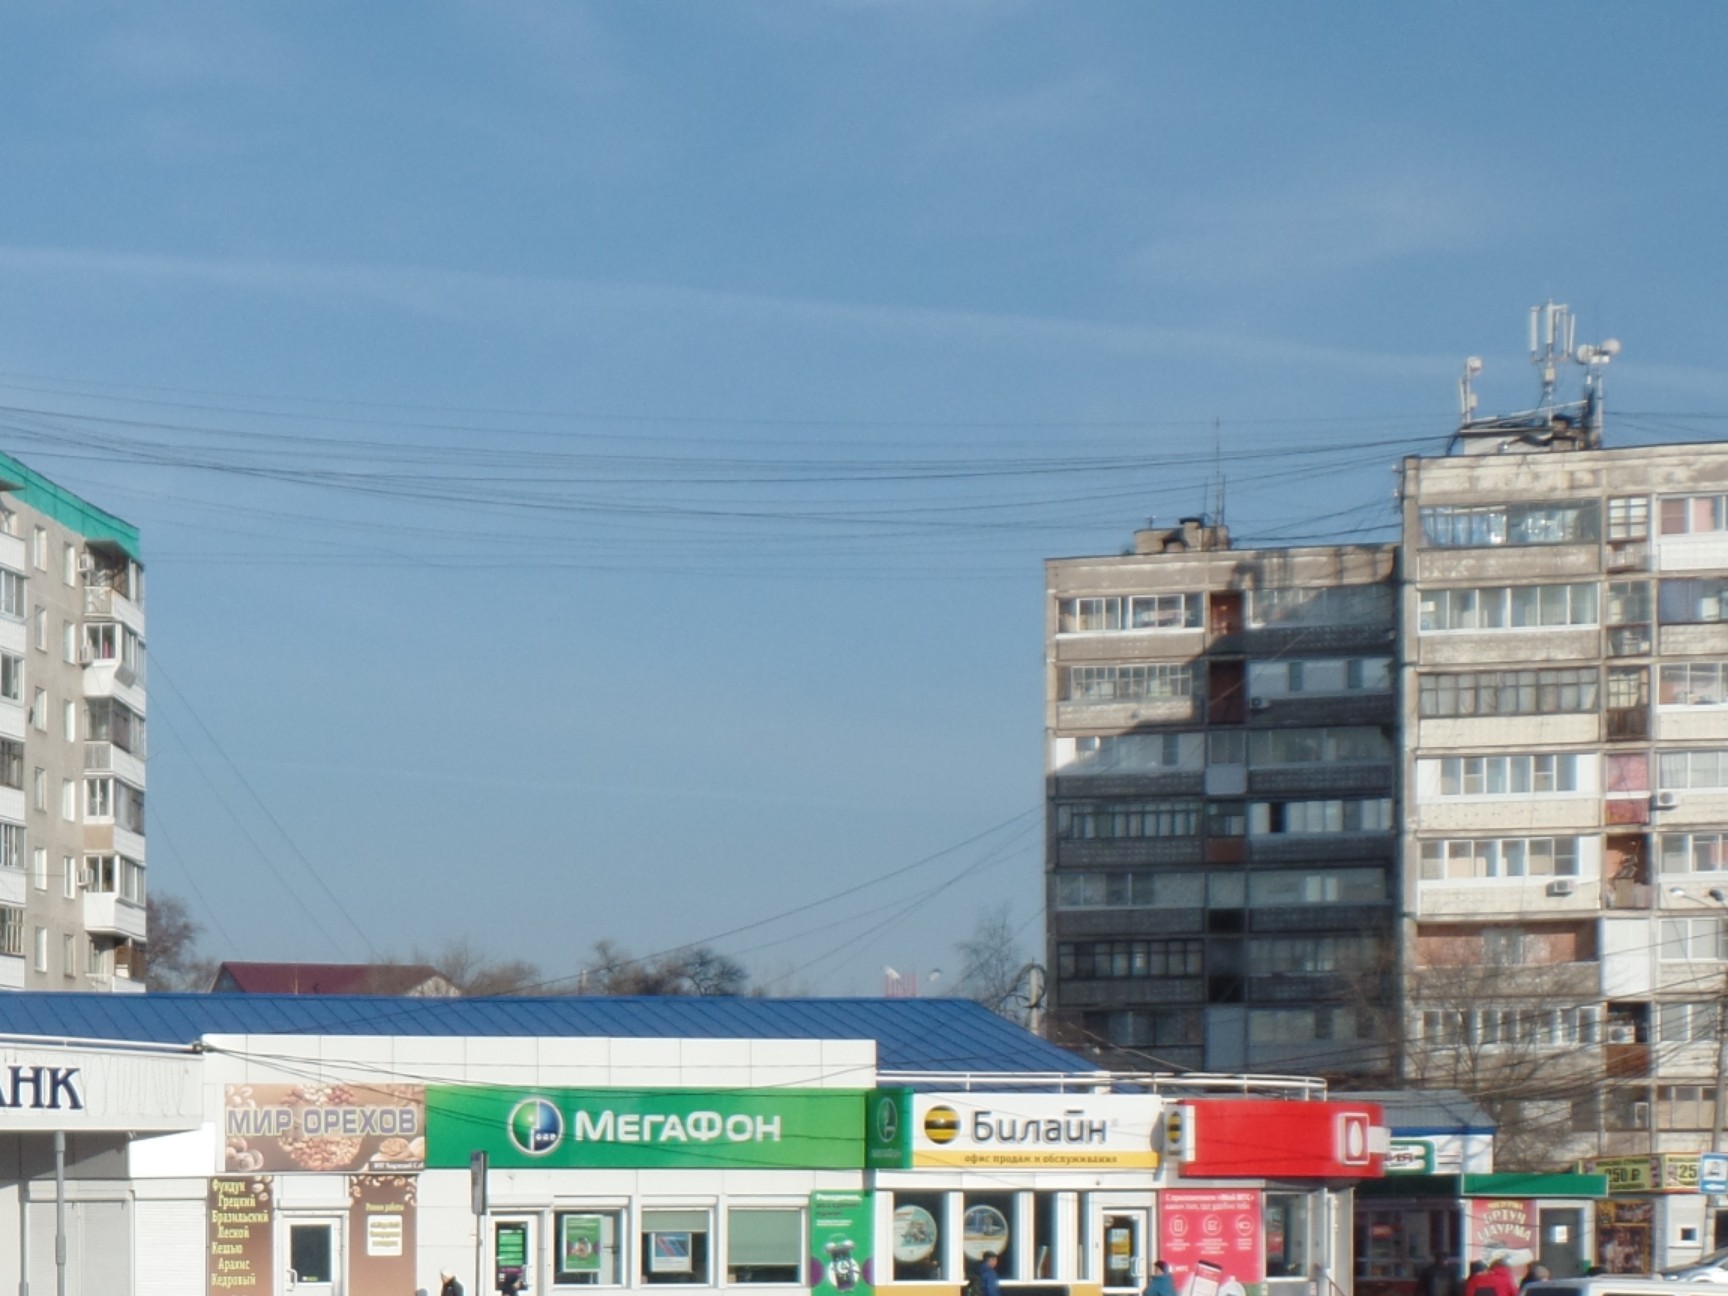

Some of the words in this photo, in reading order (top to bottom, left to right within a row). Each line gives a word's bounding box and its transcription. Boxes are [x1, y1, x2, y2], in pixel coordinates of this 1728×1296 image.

[227, 1107, 293, 1136] МИР
[303, 1107, 418, 1136] ОРЕХОВ
[973, 1109, 1107, 1143] Билайн
[964, 1154, 990, 1165] офис
[992, 1155, 1031, 1165] продаж
[1042, 1153, 1118, 1165] обслуживания
[213, 1178, 246, 1195] Фундук
[218, 1194, 256, 1210] Грецкий
[212, 1210, 269, 1226] Бразильский
[218, 1224, 250, 1239] Лесной
[212, 1241, 243, 1255] Кешью
[218, 1257, 250, 1273] Арахис
[211, 1272, 256, 1289] Кедровый
